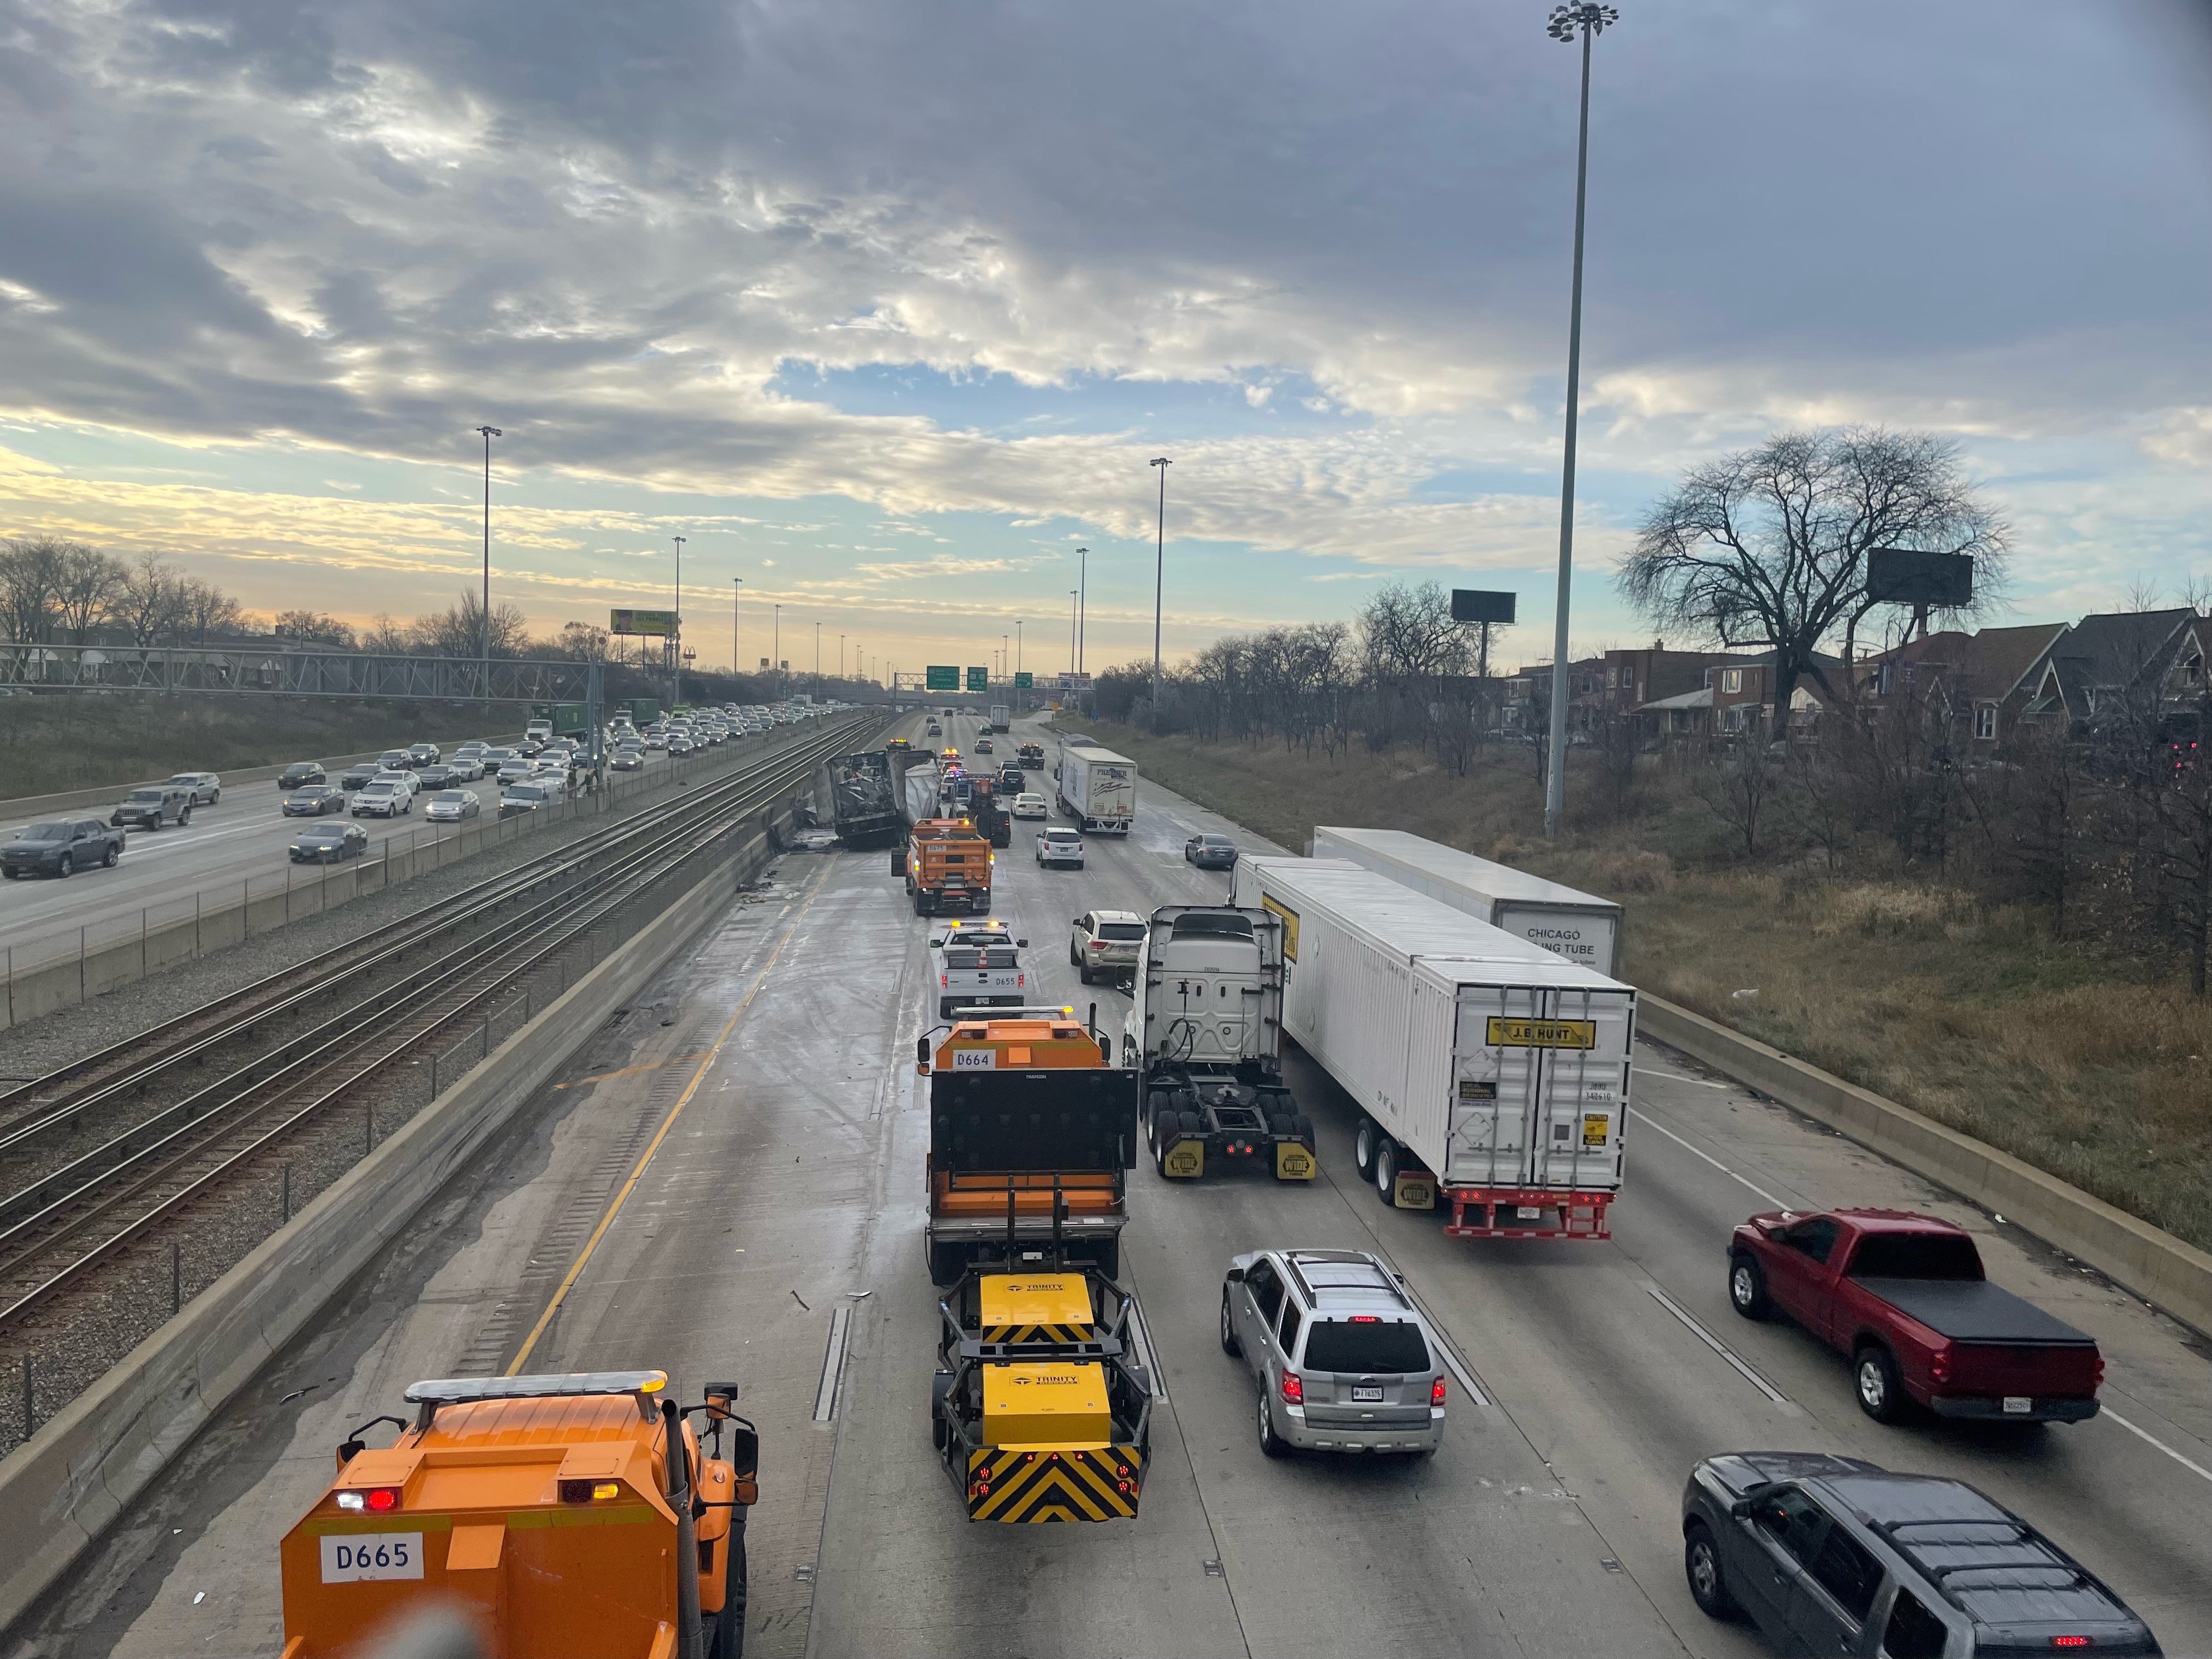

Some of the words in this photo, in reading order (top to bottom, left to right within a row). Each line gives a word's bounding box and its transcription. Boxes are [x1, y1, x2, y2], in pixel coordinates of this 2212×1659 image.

[1528, 929, 1581, 940] CHICAGO
[1565, 944, 1595, 955] TUBE
[1537, 1028, 1570, 1040] HUNT
[958, 1054, 989, 1065] D664
[1173, 1158, 1196, 1169] WIDE
[1285, 1160, 1308, 1171] WIDE
[337, 1543, 408, 1569] D665
